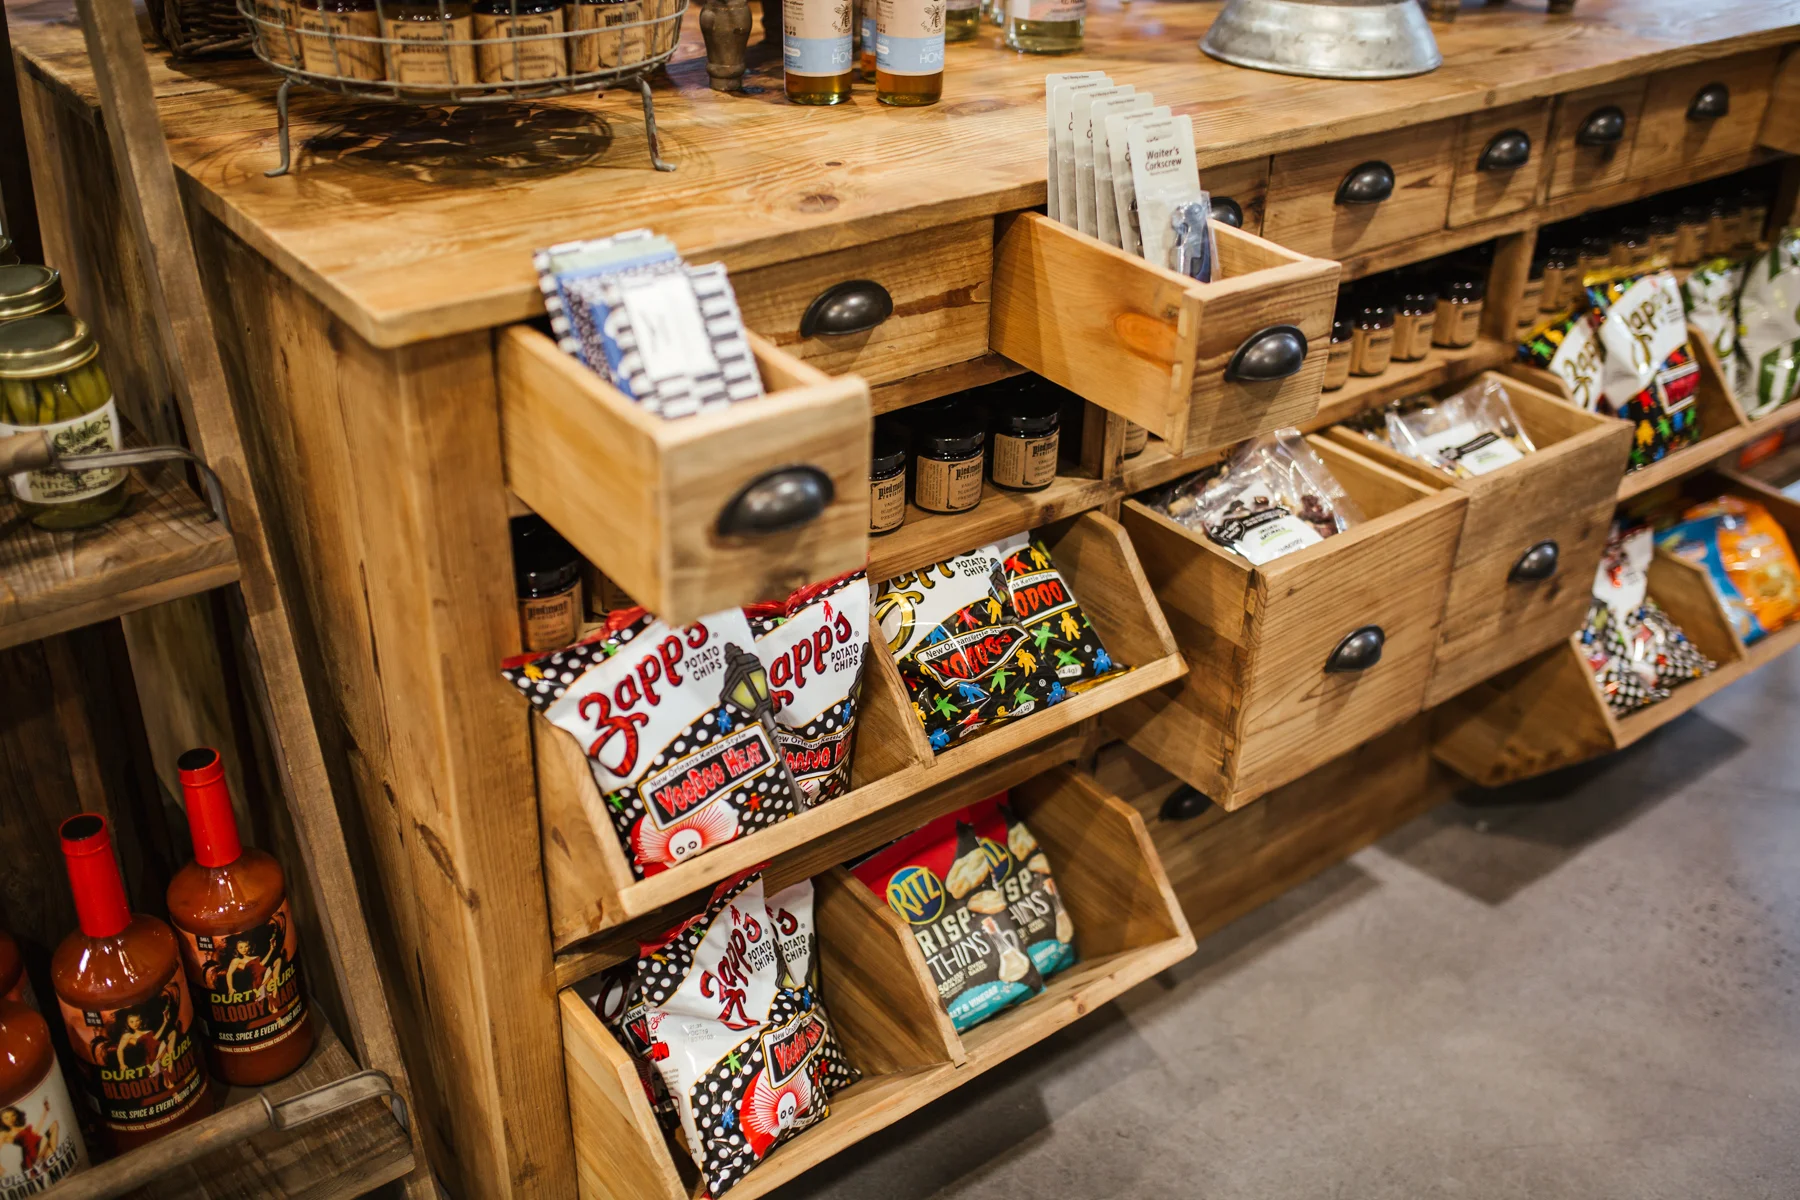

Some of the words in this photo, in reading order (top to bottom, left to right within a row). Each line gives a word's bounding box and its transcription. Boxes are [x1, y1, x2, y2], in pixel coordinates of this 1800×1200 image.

[1146, 147, 1180, 160] Waiter's
[1145, 158, 1182, 171] Corkscrew
[956, 557, 987, 569] POTATO
[964, 565, 989, 577] CHIPS
[684, 646, 720, 672] POTATO
[831, 643, 859, 663] POTATO
[926, 647, 943, 659] New
[693, 659, 722, 681] CHIPS
[834, 656, 858, 673] CHIPS
[650, 777, 668, 790] New
[668, 756, 700, 778] Orleans
[700, 744, 725, 759] Kettle
[725, 732, 747, 749] Style
[886, 866, 941, 924] RITZ
[915, 906, 971, 957] RISP
[747, 940, 772, 962] POTATO
[779, 935, 805, 952] POTATO
[755, 952, 774, 971] CHIPS
[785, 945, 807, 963] CHIPS
[926, 931, 990, 980] THINS
[211, 988, 262, 1004] DURTY
[267, 964, 296, 992] GURL
[212, 1000, 266, 1023] BLOODY
[626, 1009, 642, 1021] New
[219, 1032, 235, 1042] SASS,
[236, 1031, 253, 1041] SPICE
[254, 1030, 259, 1038] &
[773, 1032, 785, 1042] New
[101, 1065, 156, 1081] DURTY
[161, 1036, 192, 1067] GURL
[103, 1075, 160, 1100] BLOODY
[111, 1110, 128, 1120] SASS,
[129, 1108, 148, 1119] SPICE
[149, 1106, 155, 1115] &
